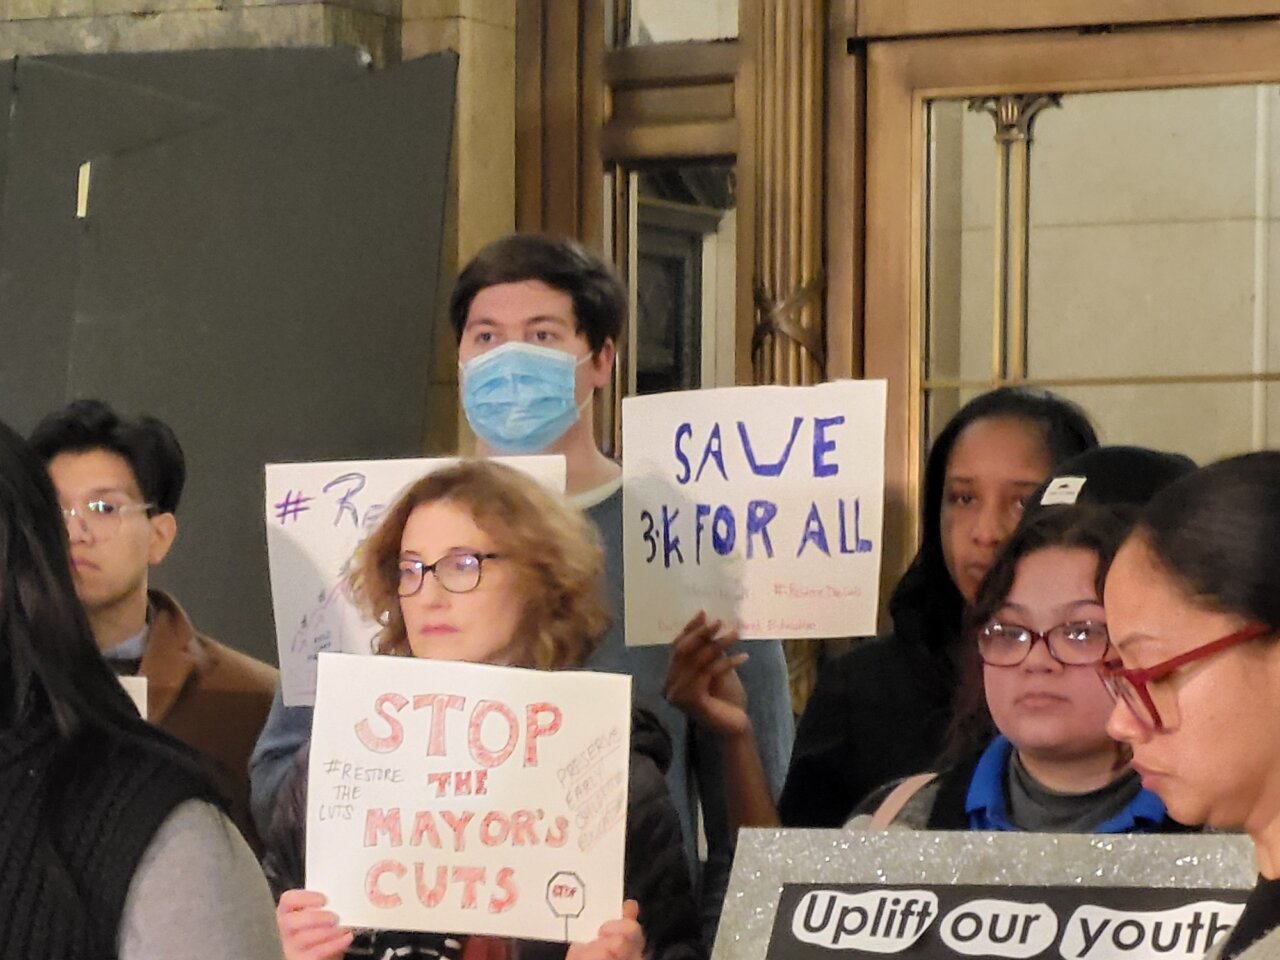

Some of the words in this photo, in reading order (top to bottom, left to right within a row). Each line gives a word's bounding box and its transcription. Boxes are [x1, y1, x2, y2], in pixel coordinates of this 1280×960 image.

[674, 415, 846, 485] SAVE
[695, 499, 778, 565] FOR
[796, 497, 873, 558] ALL
[354, 692, 563, 768] STOP
[333, 785, 361, 800] THE
[427, 769, 488, 797] THE
[319, 804, 354, 821] CUTS
[363, 807, 569, 852] MAYOR'S
[365, 858, 519, 914] CUTS
[802, 893, 933, 944] Uplift
[950, 911, 1042, 945] our
